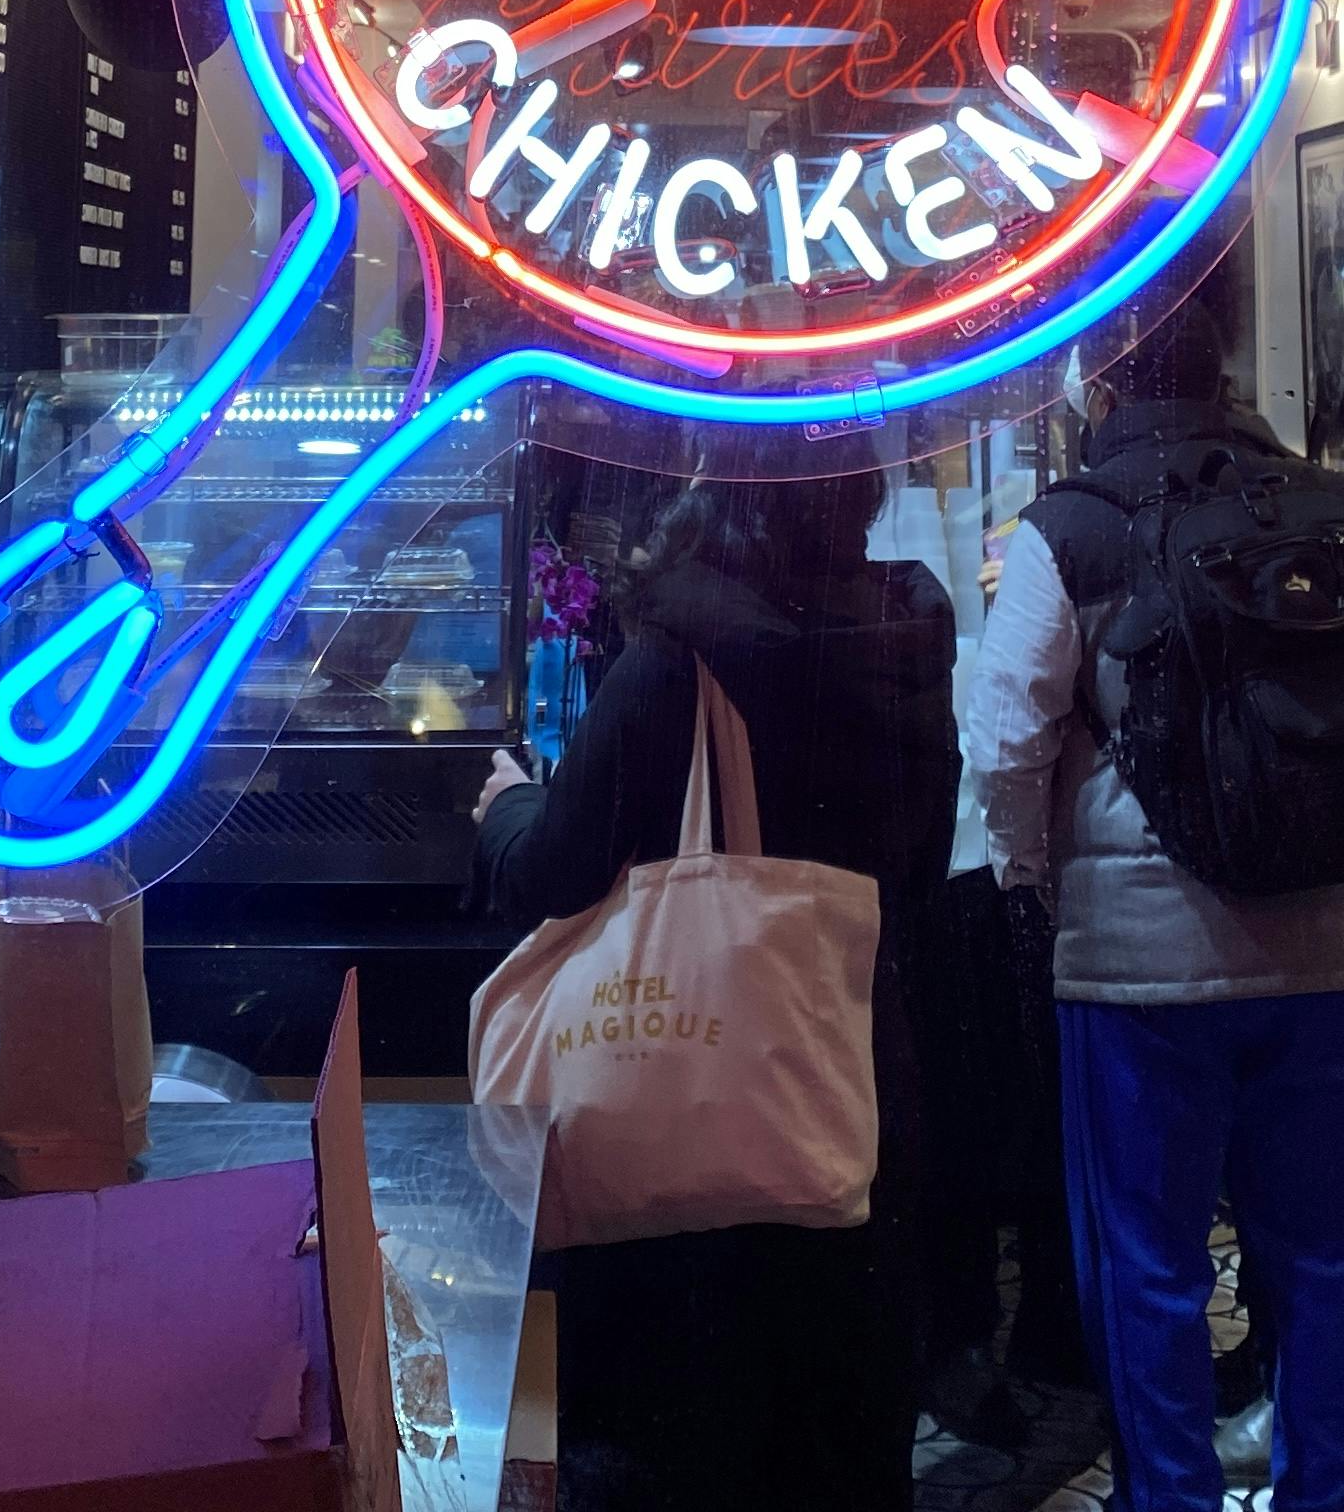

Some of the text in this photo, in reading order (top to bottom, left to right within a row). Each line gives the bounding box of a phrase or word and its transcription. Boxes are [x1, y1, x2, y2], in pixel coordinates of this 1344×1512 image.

[395, 18, 1111, 296] CHICKEN
[592, 970, 675, 1009] HÔTEL
[557, 1012, 723, 1057] MAGIQUE
